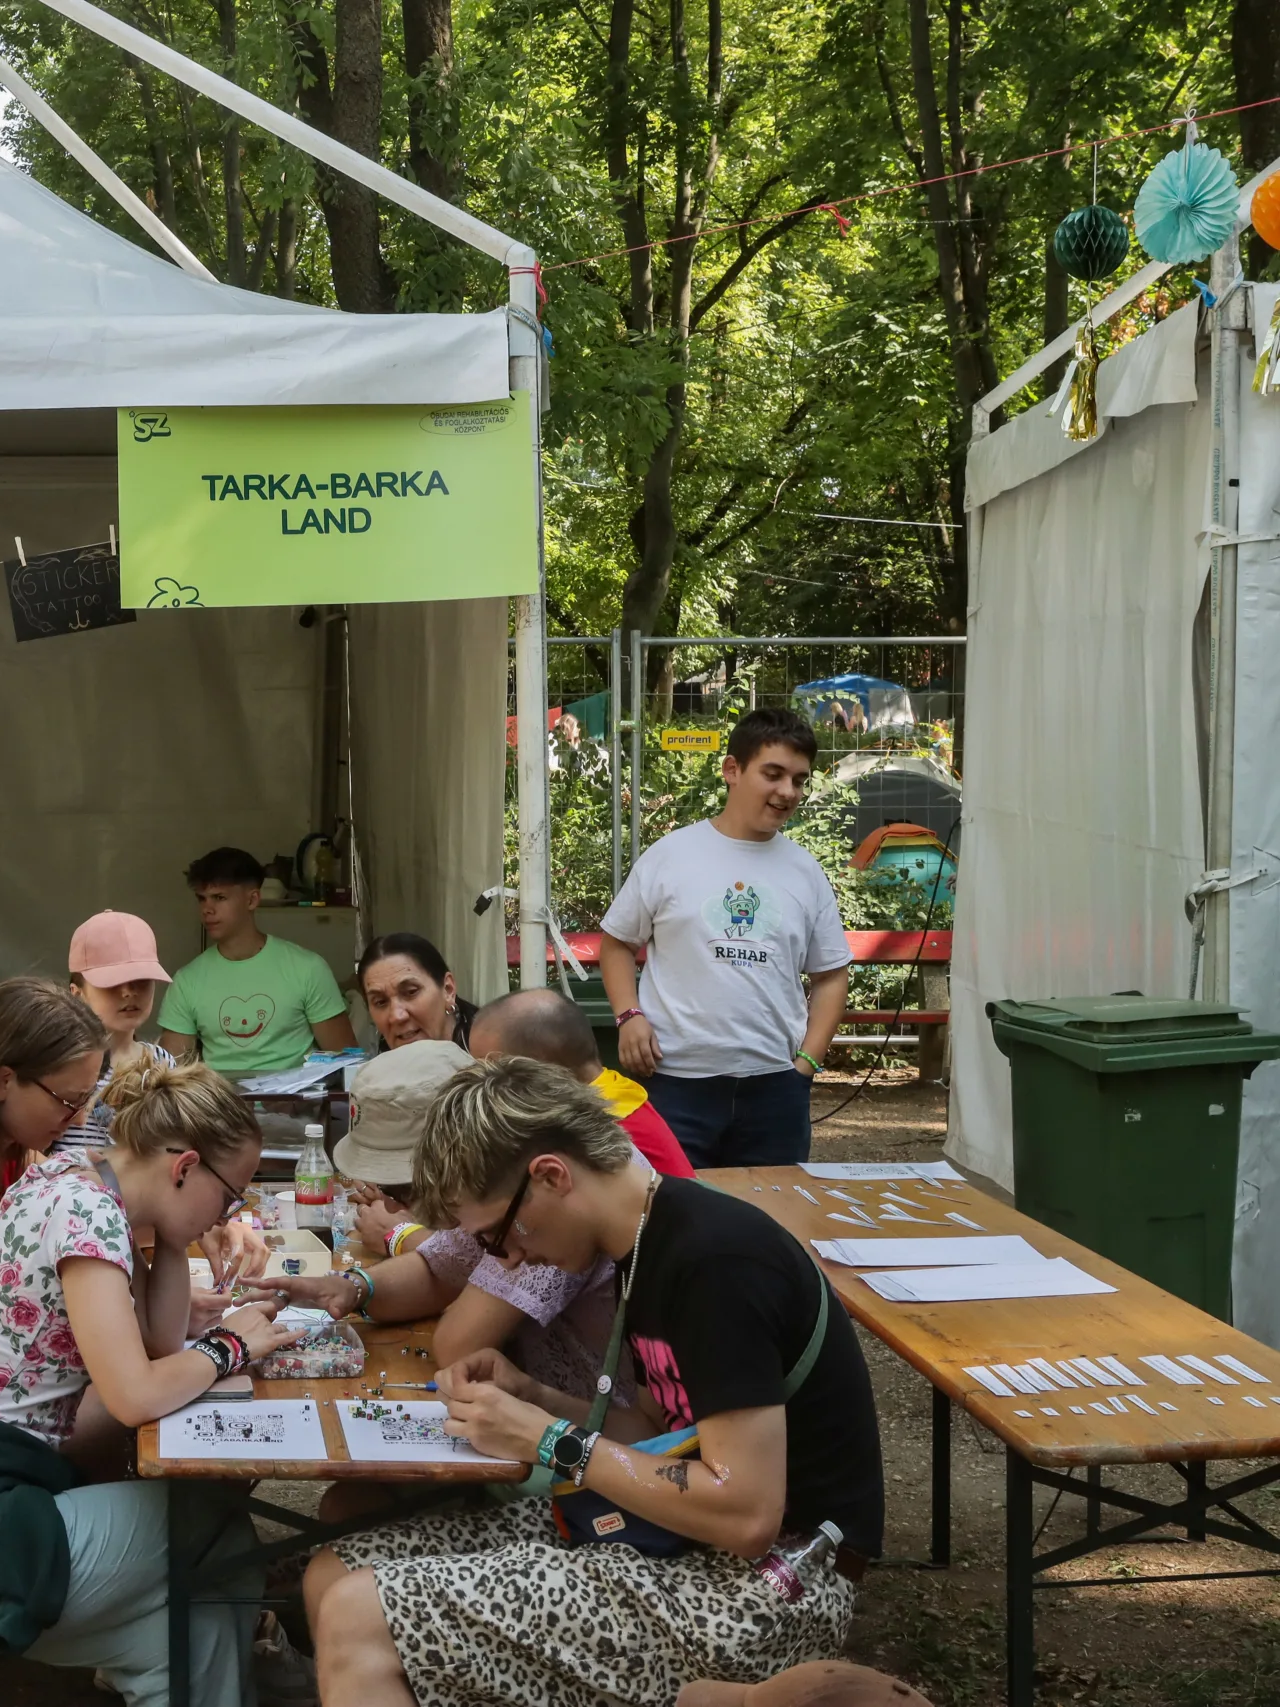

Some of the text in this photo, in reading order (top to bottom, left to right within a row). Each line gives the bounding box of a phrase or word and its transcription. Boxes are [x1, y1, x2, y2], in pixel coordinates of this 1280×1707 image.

[454, 425, 486, 434] KÖZPONT
[201, 470, 450, 501] TARKA-BARKA
[281, 507, 371, 535] LAND
[22, 559, 120, 595] STICKER
[33, 593, 101, 613] TATTOO
[667, 735, 711, 745] profirent
[715, 946, 767, 963] REHAB
[731, 959, 753, 968] KUPA
